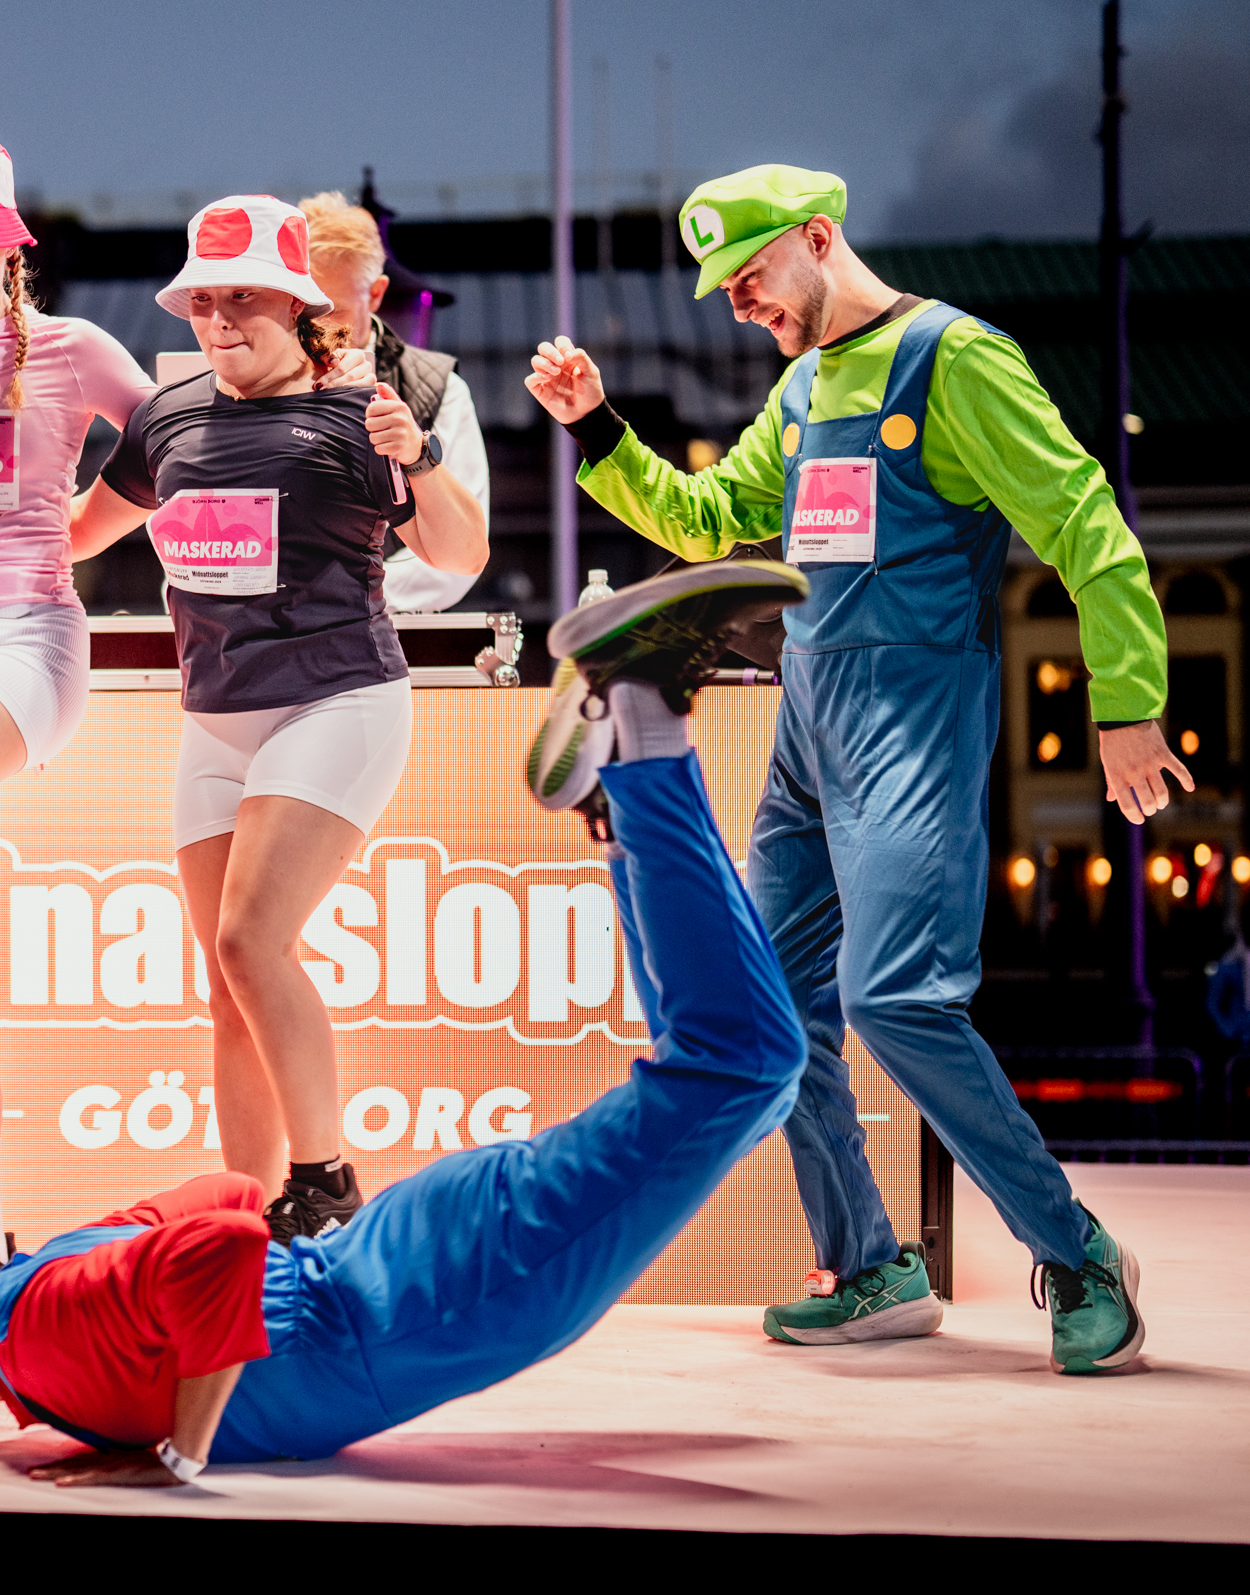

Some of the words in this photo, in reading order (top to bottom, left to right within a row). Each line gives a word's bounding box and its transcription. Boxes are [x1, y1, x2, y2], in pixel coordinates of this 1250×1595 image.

[690, 215, 715, 249] L
[792, 508, 859, 527] ASKERAD
[163, 540, 262, 559] MASKERAD
[191, 570, 229, 579] Midnattsloppet
[58, 1070, 533, 1151] GÖORG
